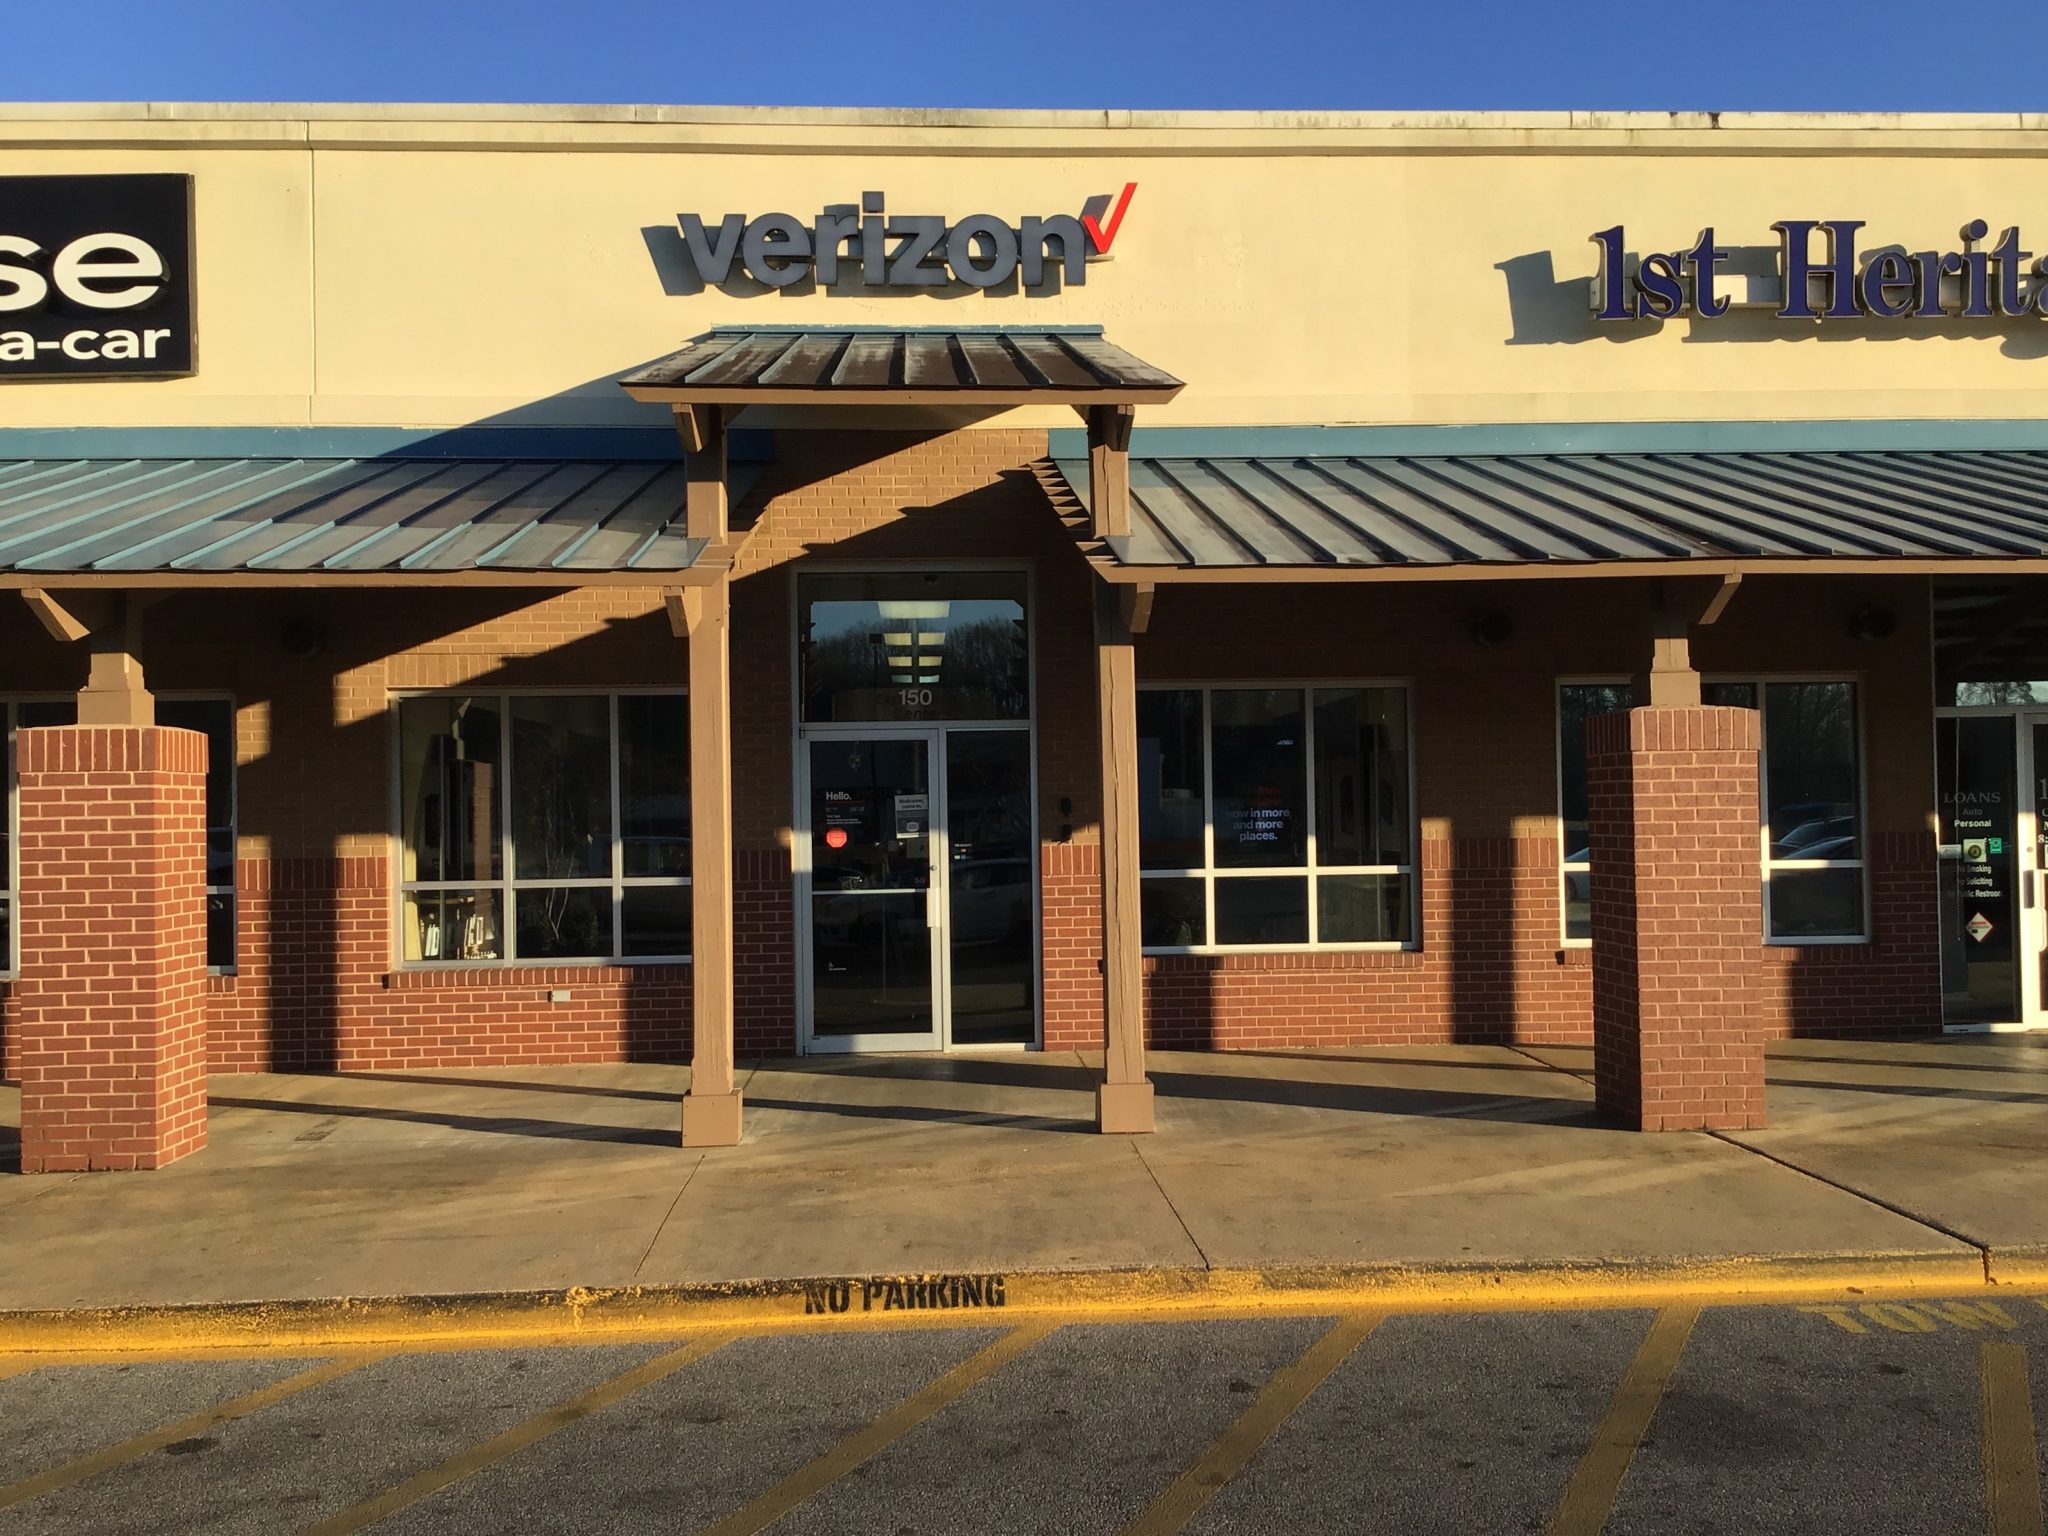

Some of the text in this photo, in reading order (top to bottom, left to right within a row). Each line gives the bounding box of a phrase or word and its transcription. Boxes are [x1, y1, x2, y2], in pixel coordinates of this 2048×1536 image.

[677, 191, 1087, 288] verizon
[1589, 225, 1731, 320] 1st
[898, 689, 933, 706] 150
[825, 791, 852, 801] Hello.
[1943, 791, 2001, 804] LOANS
[1226, 807, 1290, 818] now in more
[1962, 808, 1983, 816] Auto
[1233, 820, 1284, 829] and more
[1954, 819, 1992, 828] Personal
[1239, 831, 1278, 842] places.
[1966, 864, 1992, 874] Smoking
[1966, 877, 1993, 887] Soliciting
[805, 1274, 1006, 1314] NO PARKING
